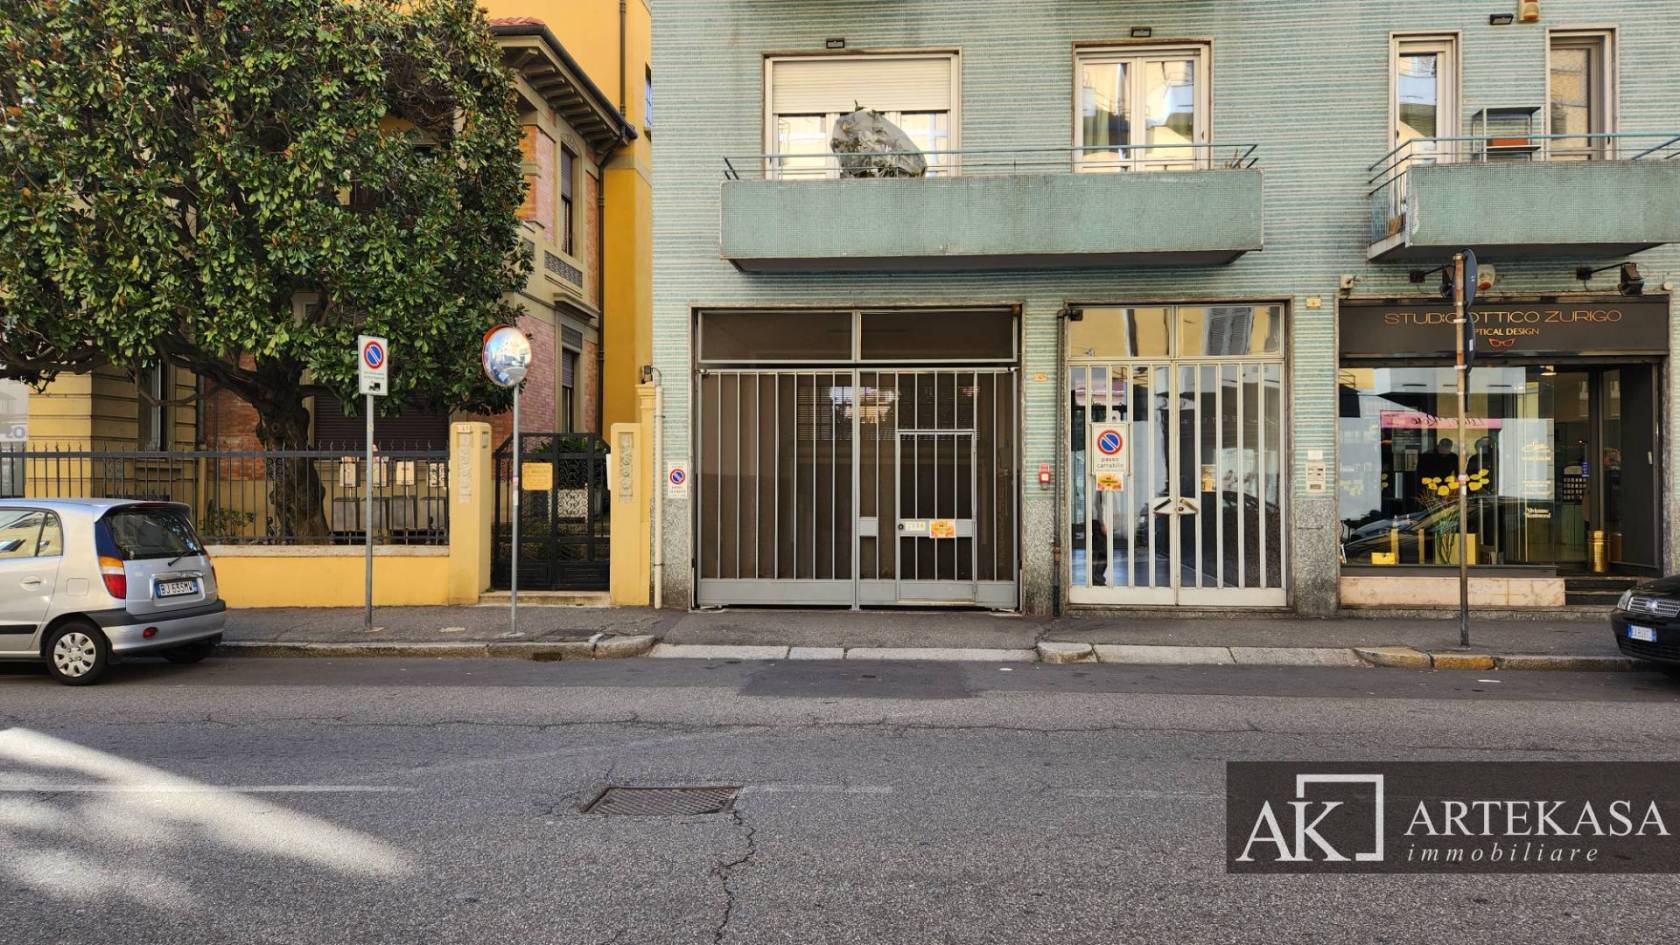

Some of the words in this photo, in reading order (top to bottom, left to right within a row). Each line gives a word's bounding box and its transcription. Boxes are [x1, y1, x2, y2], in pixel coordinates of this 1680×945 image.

[1384, 311, 1458, 325] STUDIO
[1544, 309, 1622, 323] ZURIGO
[1472, 327, 1504, 336] PTICAL
[1505, 327, 1540, 335] DESIGN
